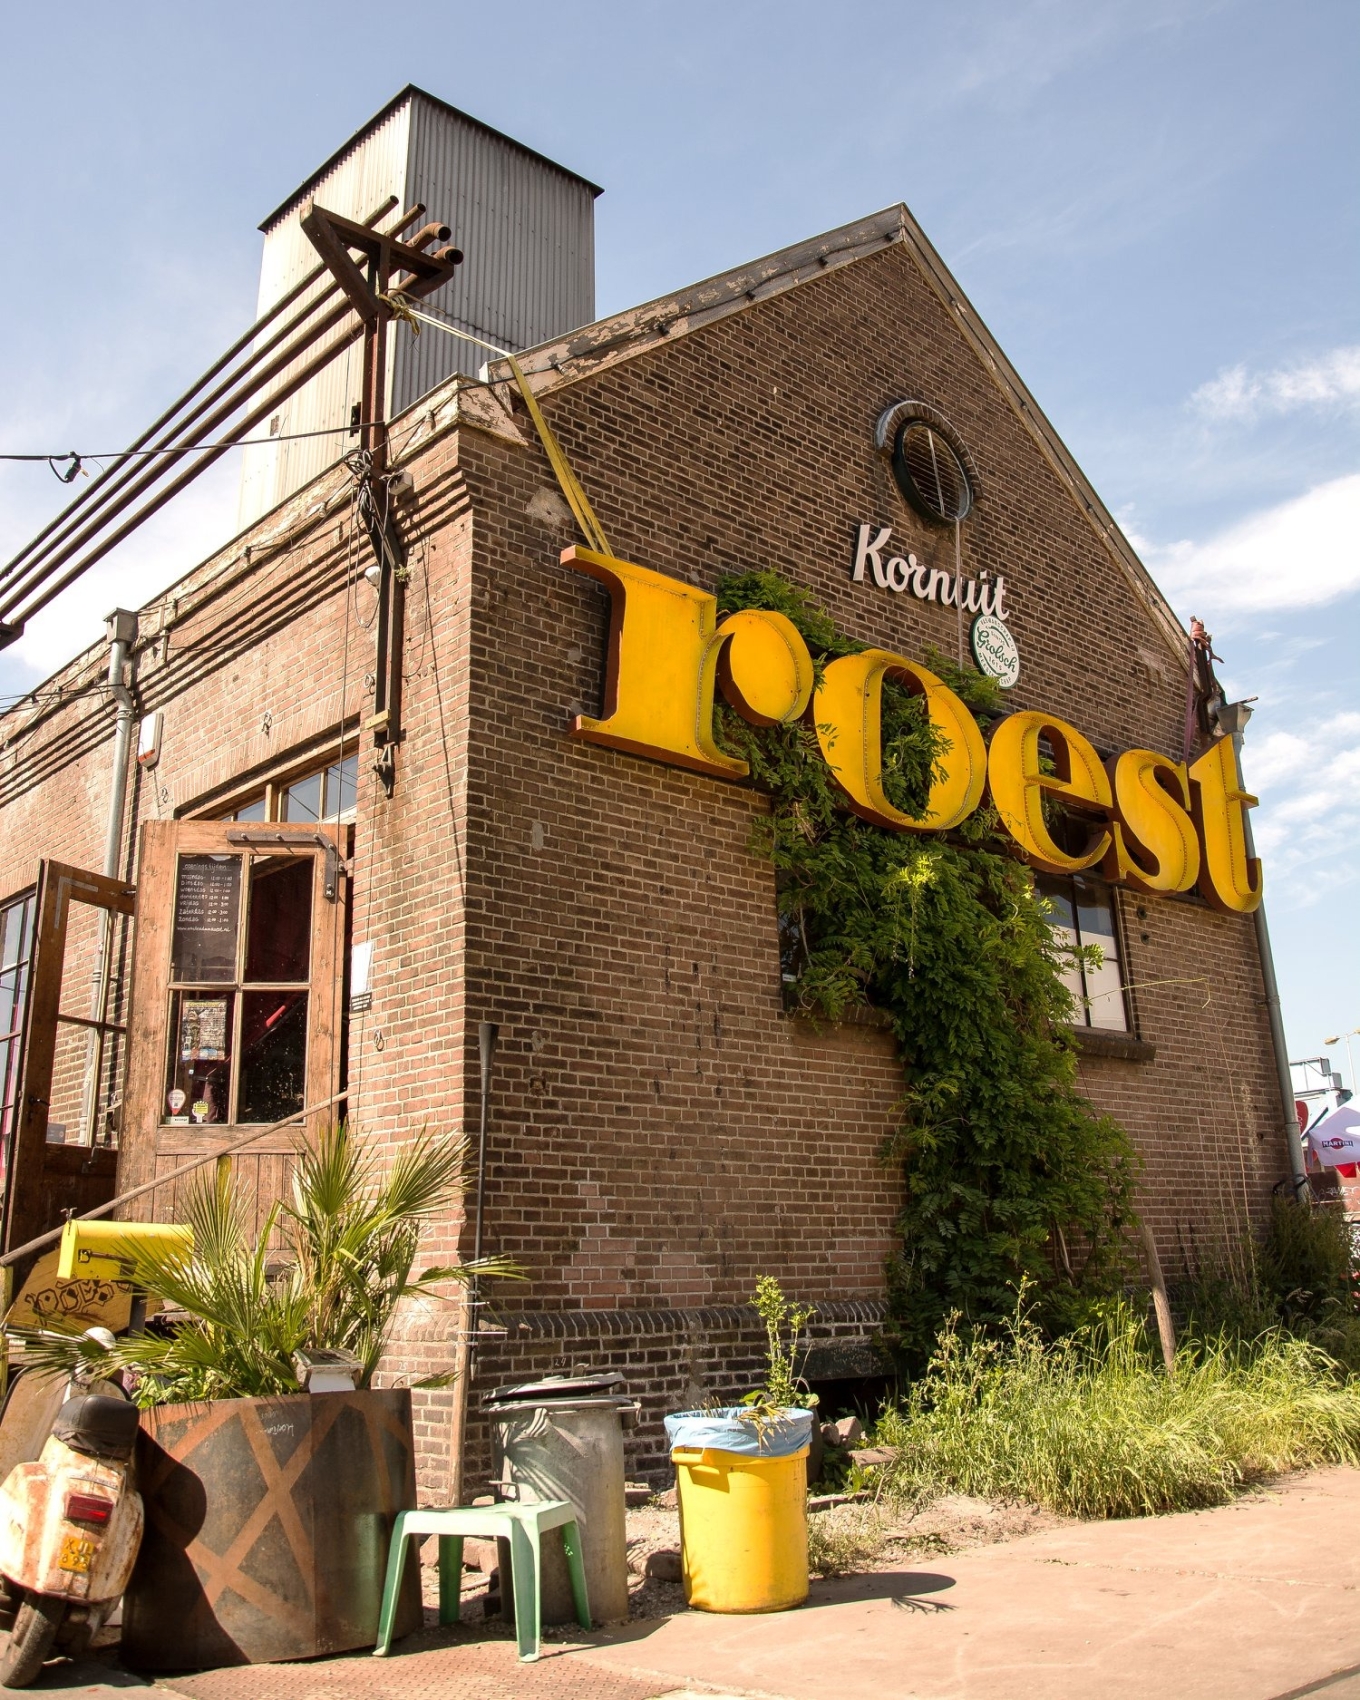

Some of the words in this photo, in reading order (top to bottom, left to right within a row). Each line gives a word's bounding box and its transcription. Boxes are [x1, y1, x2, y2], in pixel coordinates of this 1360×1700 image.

[853, 524, 1010, 621] Kornuit
[976, 626, 1018, 673] Grolsch
[561, 544, 1262, 913] roest
